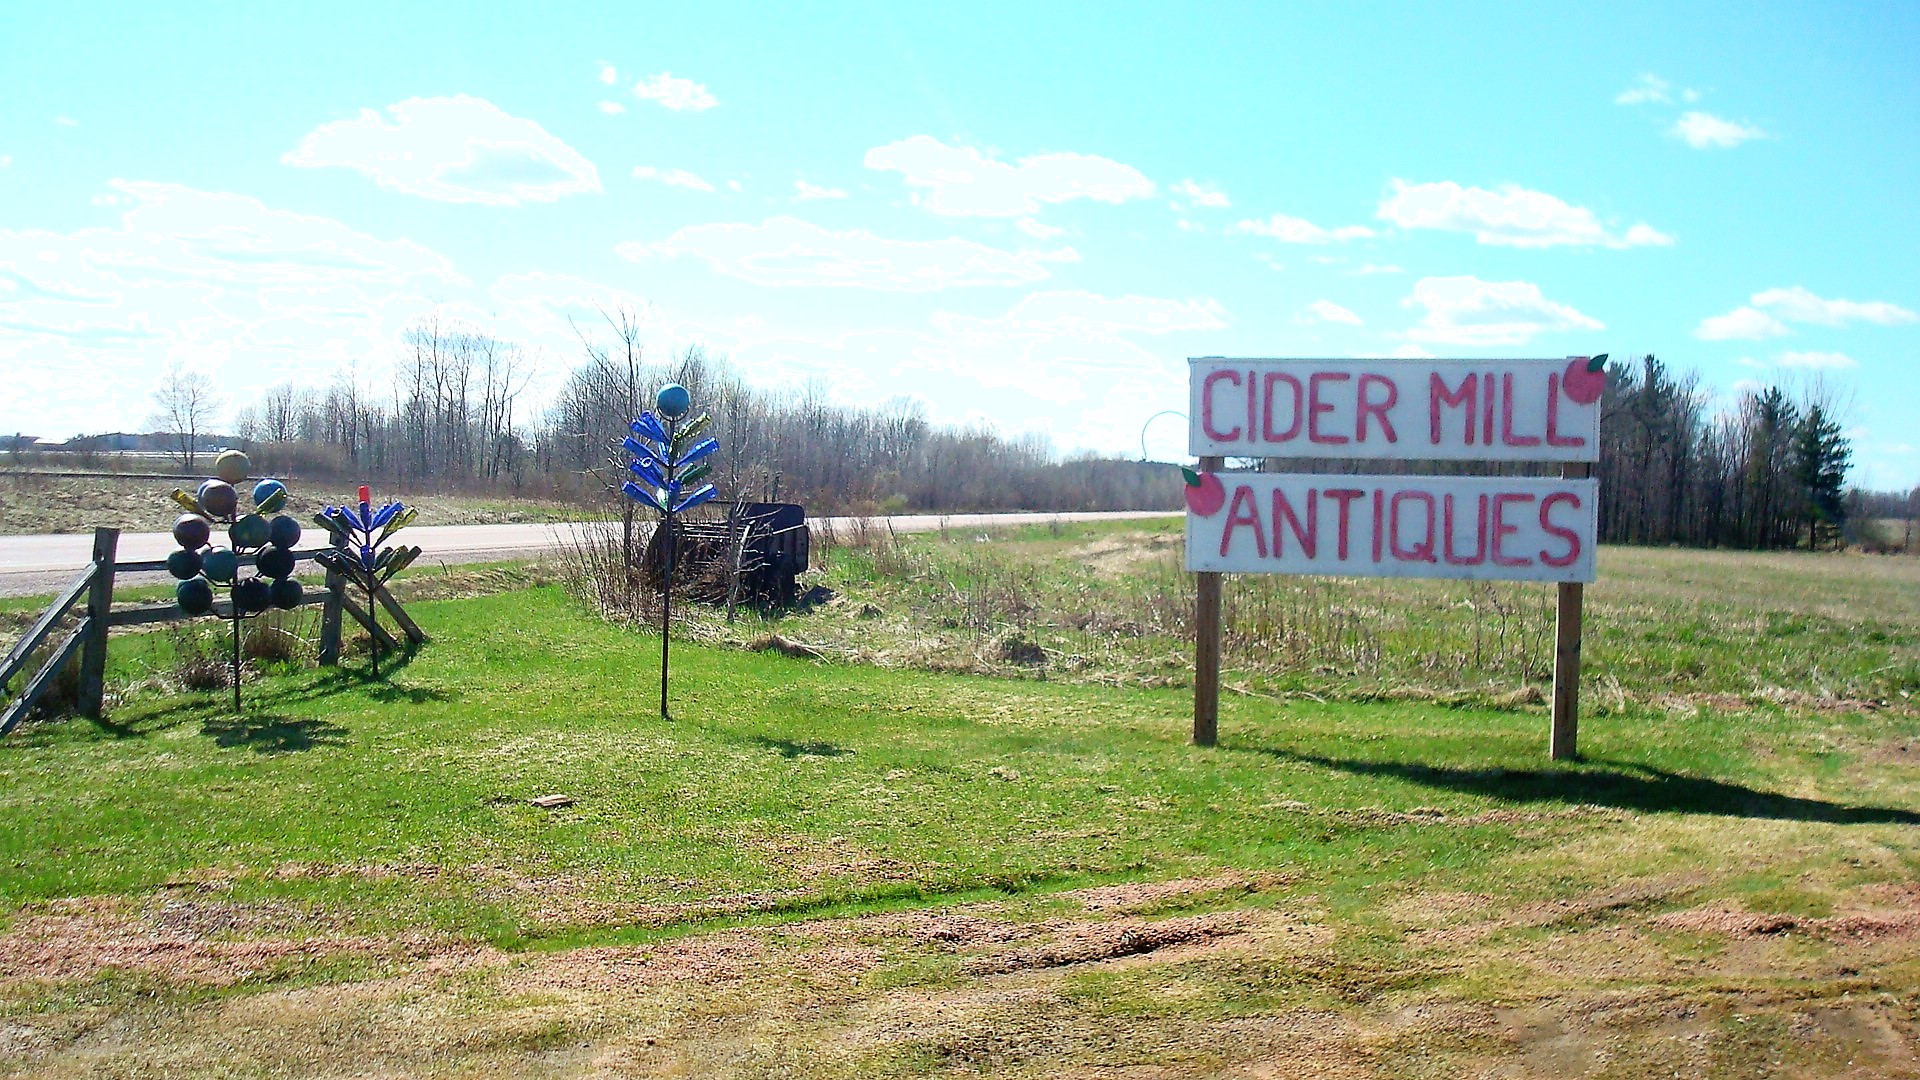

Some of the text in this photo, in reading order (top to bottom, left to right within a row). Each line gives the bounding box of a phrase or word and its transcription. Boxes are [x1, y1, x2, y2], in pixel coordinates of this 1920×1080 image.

[1202, 369, 1585, 446] CIDER MILL
[1219, 485, 1582, 568] ANTIQUES
